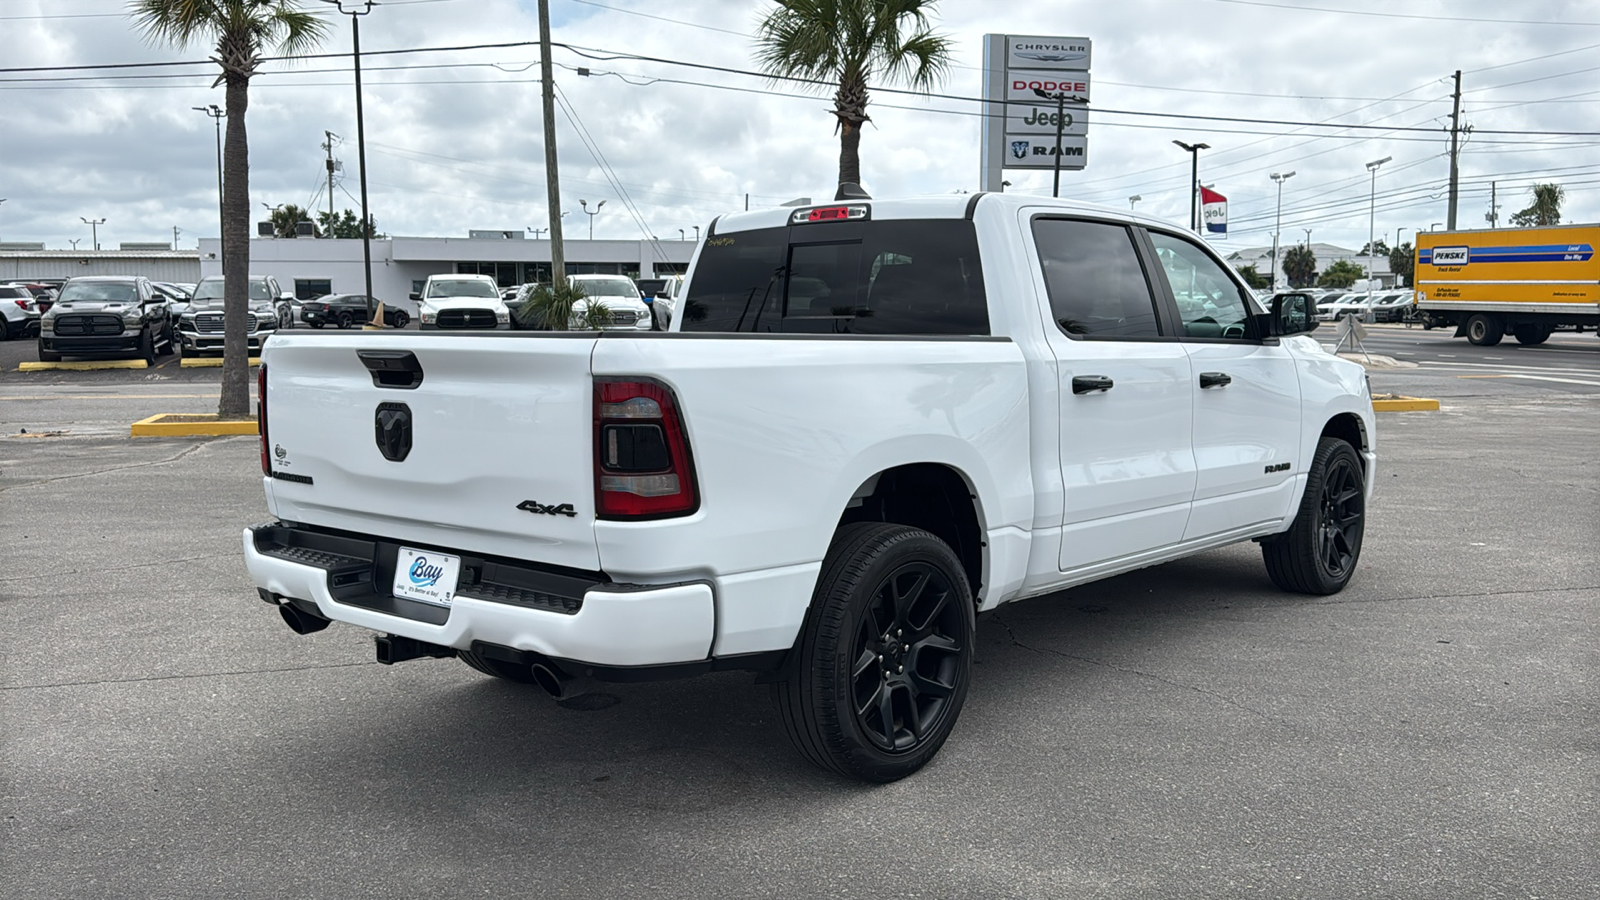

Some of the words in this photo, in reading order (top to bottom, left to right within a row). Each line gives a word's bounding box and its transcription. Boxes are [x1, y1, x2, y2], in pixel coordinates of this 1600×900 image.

[1015, 44, 1085, 52] CHRYSLER
[1013, 81, 1086, 92] DODGE
[1024, 108, 1073, 130] Jeep
[1032, 146, 1083, 156] RAM
[1435, 251, 1466, 260] PENSKE
[1264, 462, 1291, 474] RAM
[412, 556, 443, 586] Bay
